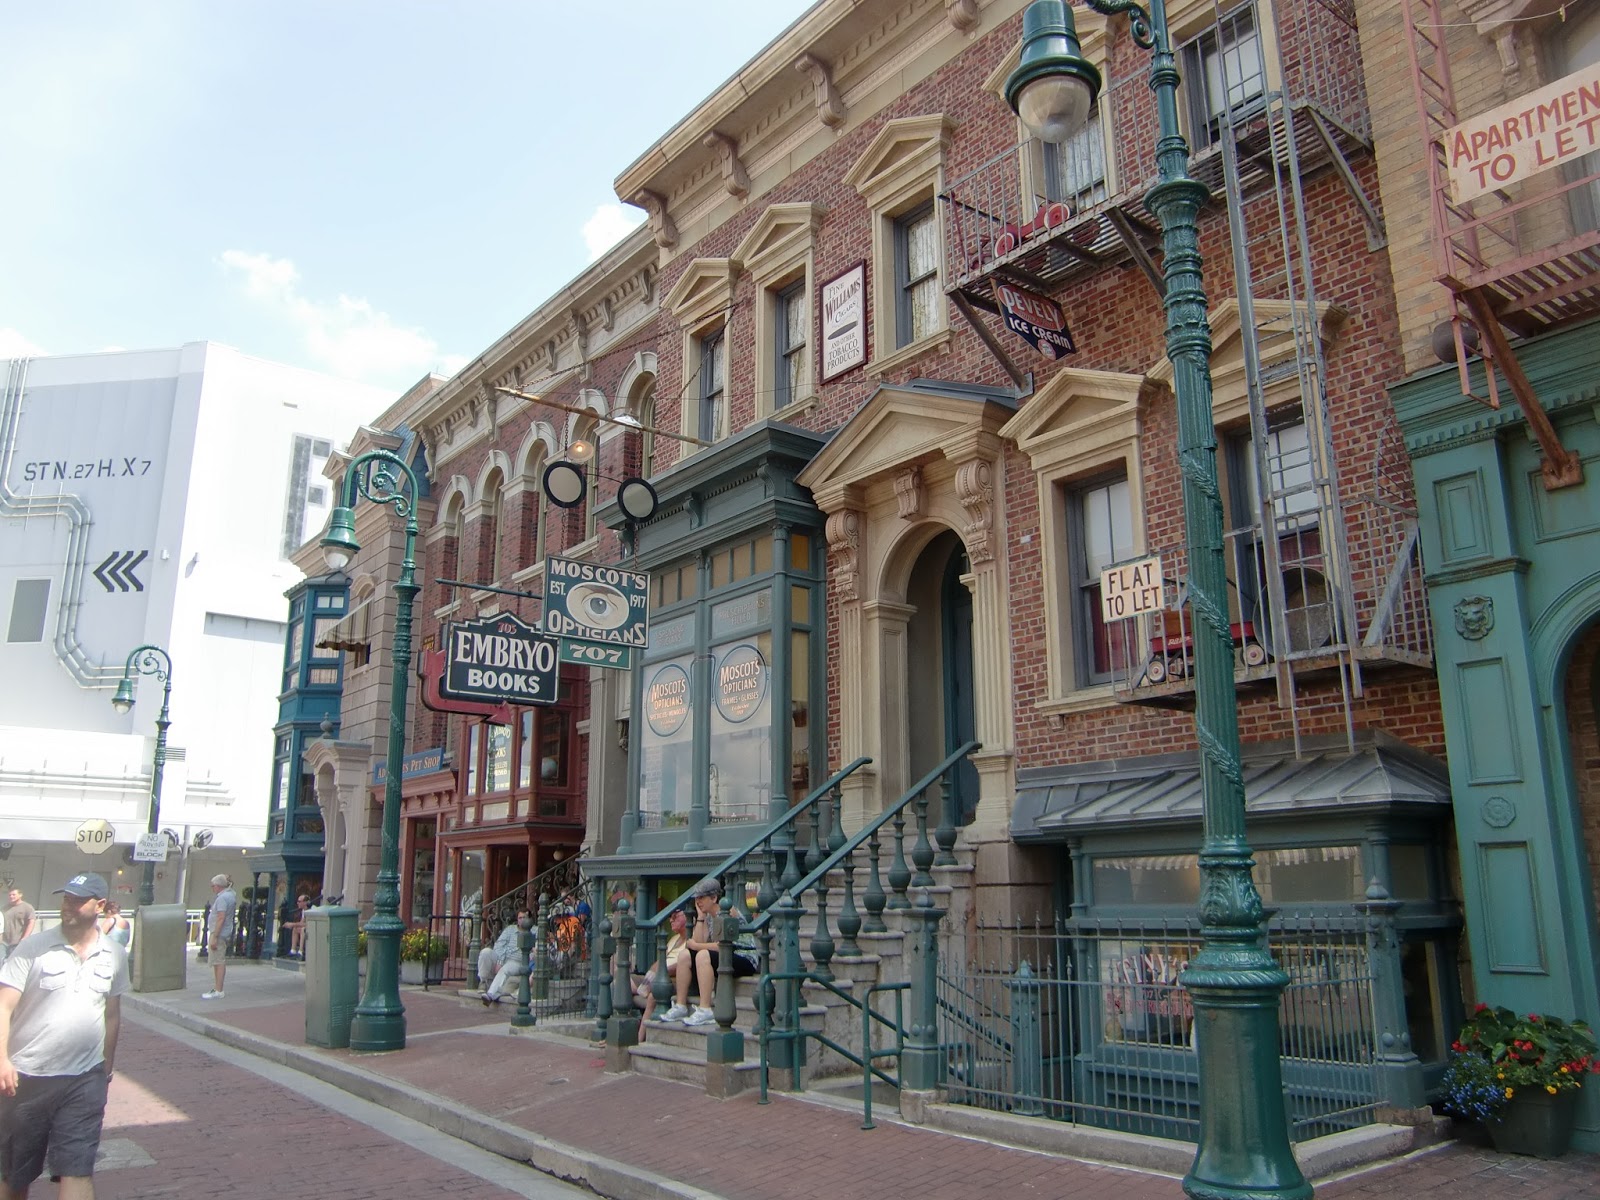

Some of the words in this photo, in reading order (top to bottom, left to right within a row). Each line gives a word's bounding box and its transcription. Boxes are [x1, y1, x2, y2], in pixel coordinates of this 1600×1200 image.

[1468, 153, 1516, 189] TO
[1535, 113, 1600, 166] LET
[825, 277, 861, 323] WILLIAMS
[834, 300, 856, 323] CIGARS
[1001, 287, 1062, 333] PEVELY
[1008, 316, 1030, 334] ICE
[1032, 325, 1072, 350] CREAM
[827, 346, 860, 371] PRODUCTS
[828, 338, 858, 361] TOBACCO
[551, 559, 647, 590] MOSCOT'S
[1108, 562, 1153, 595] FLAT
[550, 580, 567, 596] EST.
[629, 593, 647, 609] 1917
[1106, 594, 1125, 617] TO
[1132, 586, 1160, 612] LET
[497, 621, 518, 634] 705
[547, 609, 646, 645] OPTICIANS
[454, 630, 555, 673] EMBRYO
[569, 643, 623, 663] 707
[467, 668, 540, 694] BOOKS
[720, 656, 760, 687] MOSCOT'S
[651, 676, 686, 703] MOSCOT'S
[723, 677, 757, 695] OPTICIANS
[654, 694, 683, 710] OPTICIANS
[411, 760, 422, 772] PET
[424, 755, 441, 769] SHOP
[77, 830, 113, 843] STOP
[146, 834, 159, 842] NO
